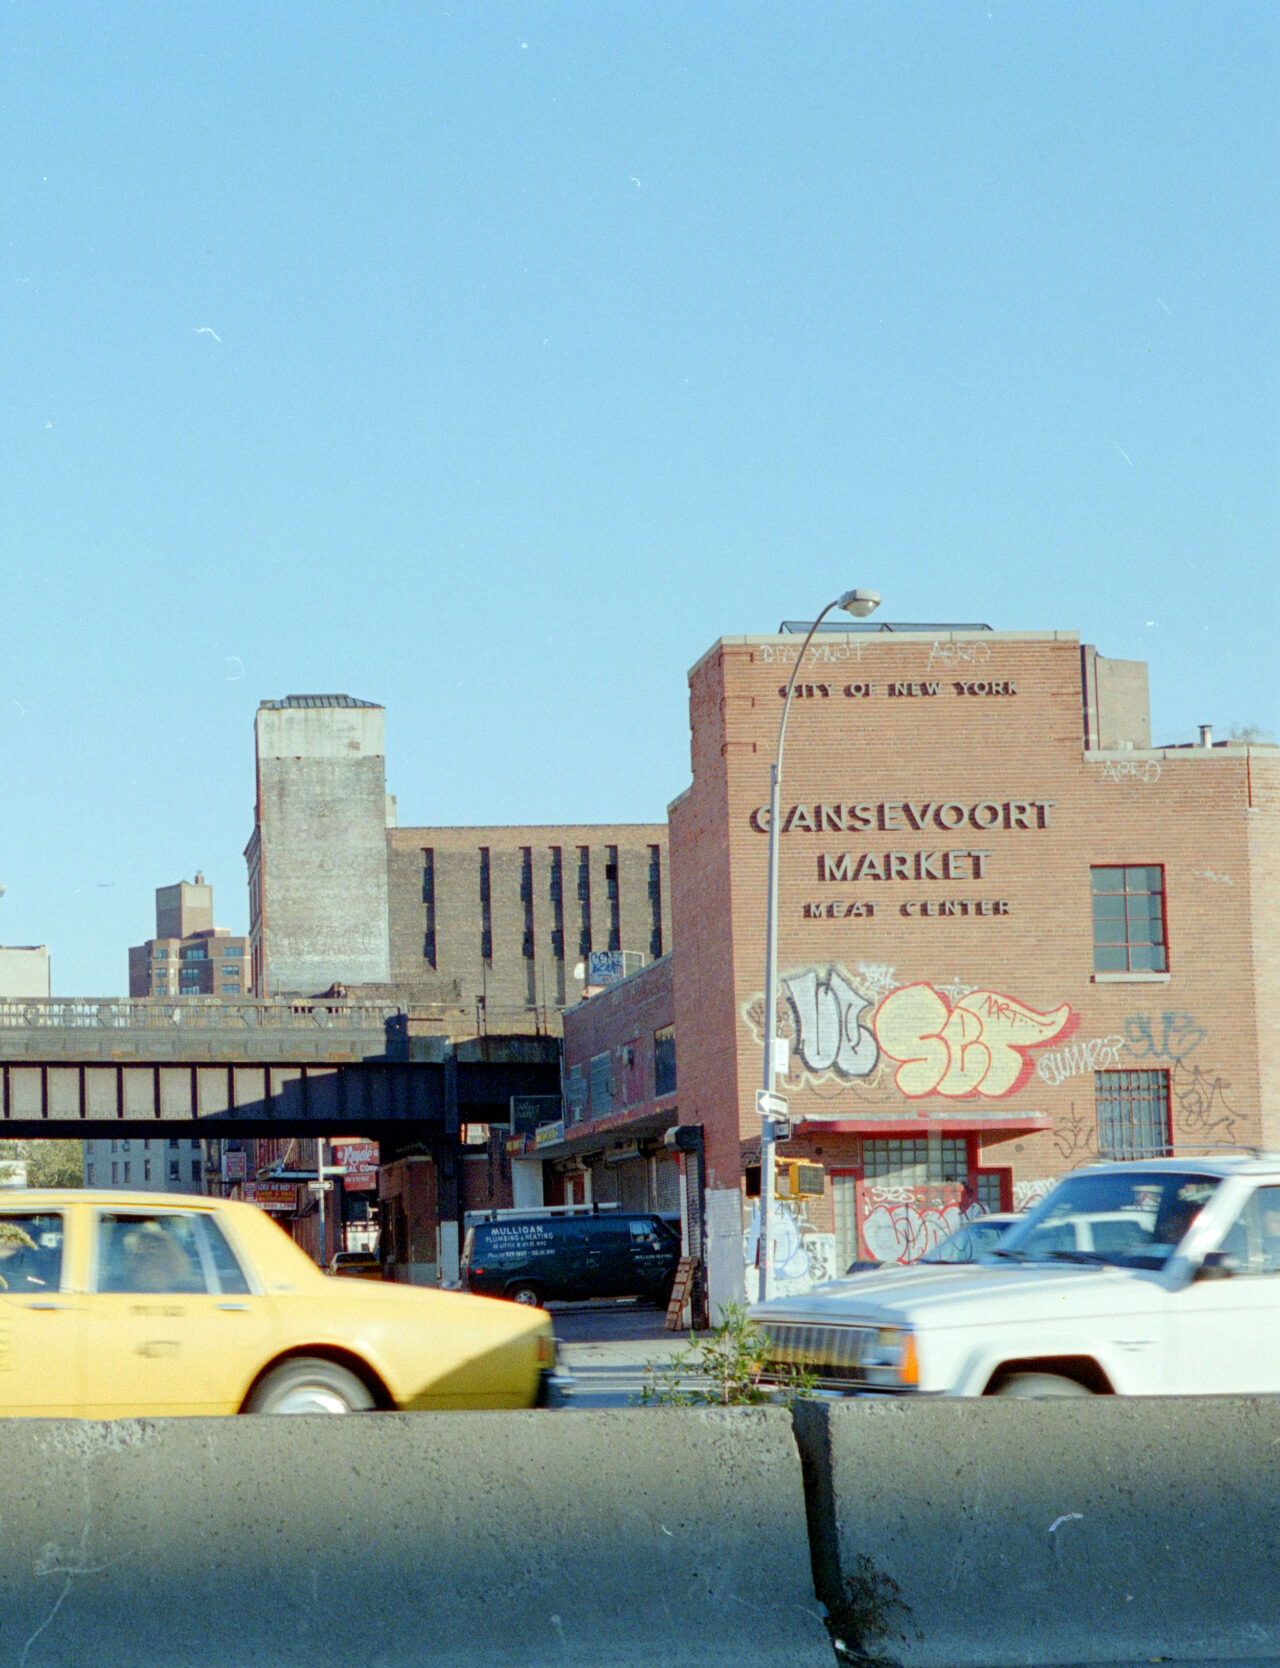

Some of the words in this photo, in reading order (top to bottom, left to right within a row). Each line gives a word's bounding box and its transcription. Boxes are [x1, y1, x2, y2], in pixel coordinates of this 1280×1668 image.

[779, 683, 832, 698] CITY
[845, 683, 876, 698] OF
[888, 682, 941, 697] NEW
[952, 681, 1018, 696] YORK
[750, 801, 1057, 833] GANSEVOORT
[817, 850, 992, 882] MARKET
[803, 901, 879, 918] MEAT
[900, 900, 1011, 917] CENTER
[485, 1235, 520, 1243] PLUMBING
[525, 1232, 554, 1241] HEATING
[491, 1225, 543, 1236] MULLIGAN
